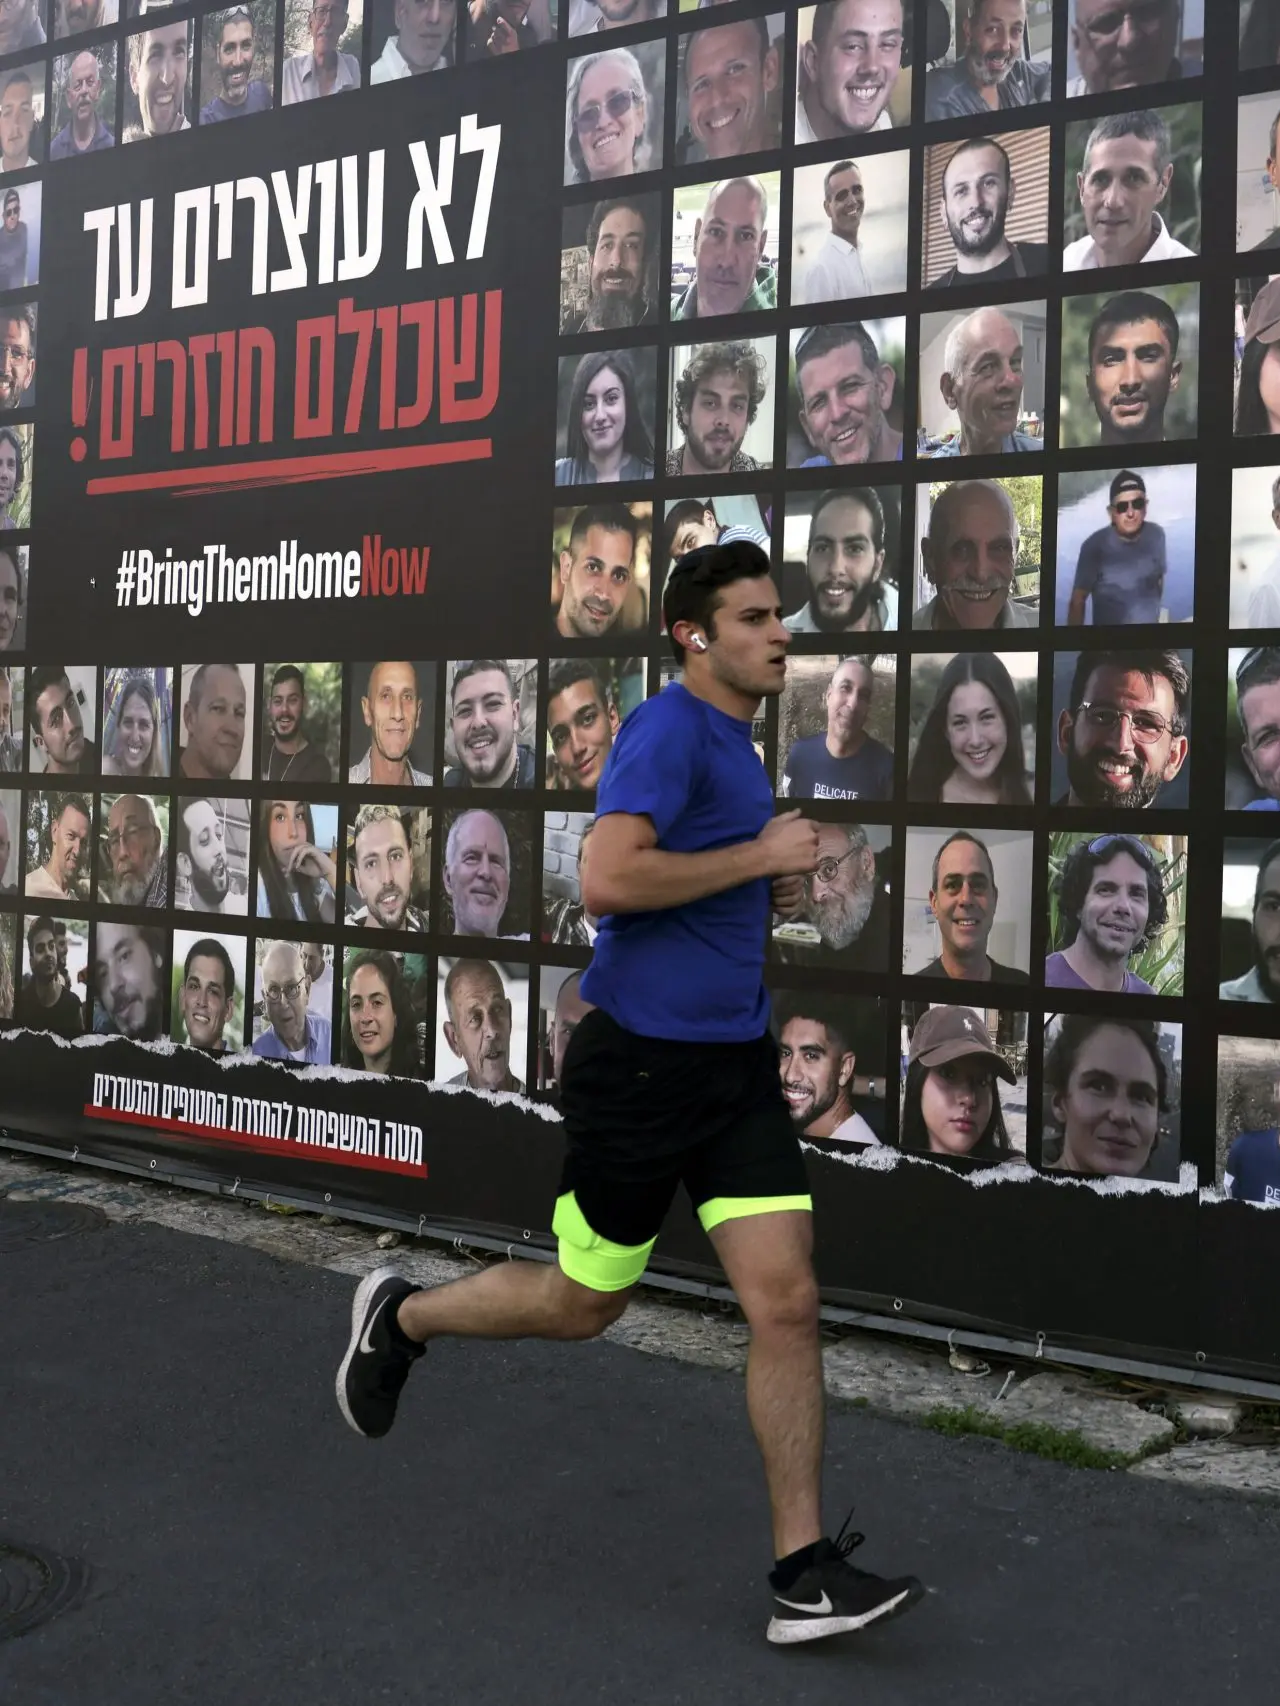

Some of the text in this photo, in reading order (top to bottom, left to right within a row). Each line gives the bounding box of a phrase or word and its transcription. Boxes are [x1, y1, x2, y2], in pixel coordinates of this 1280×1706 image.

[84, 113, 501, 322] לא עוצרים עד
[70, 290, 503, 462] שכולם חוזרים!
[116, 534, 430, 616] #BringThemHomeNow
[93, 1073, 423, 1166] מטה המשפחות להחזרת החטופים והנעדרים
